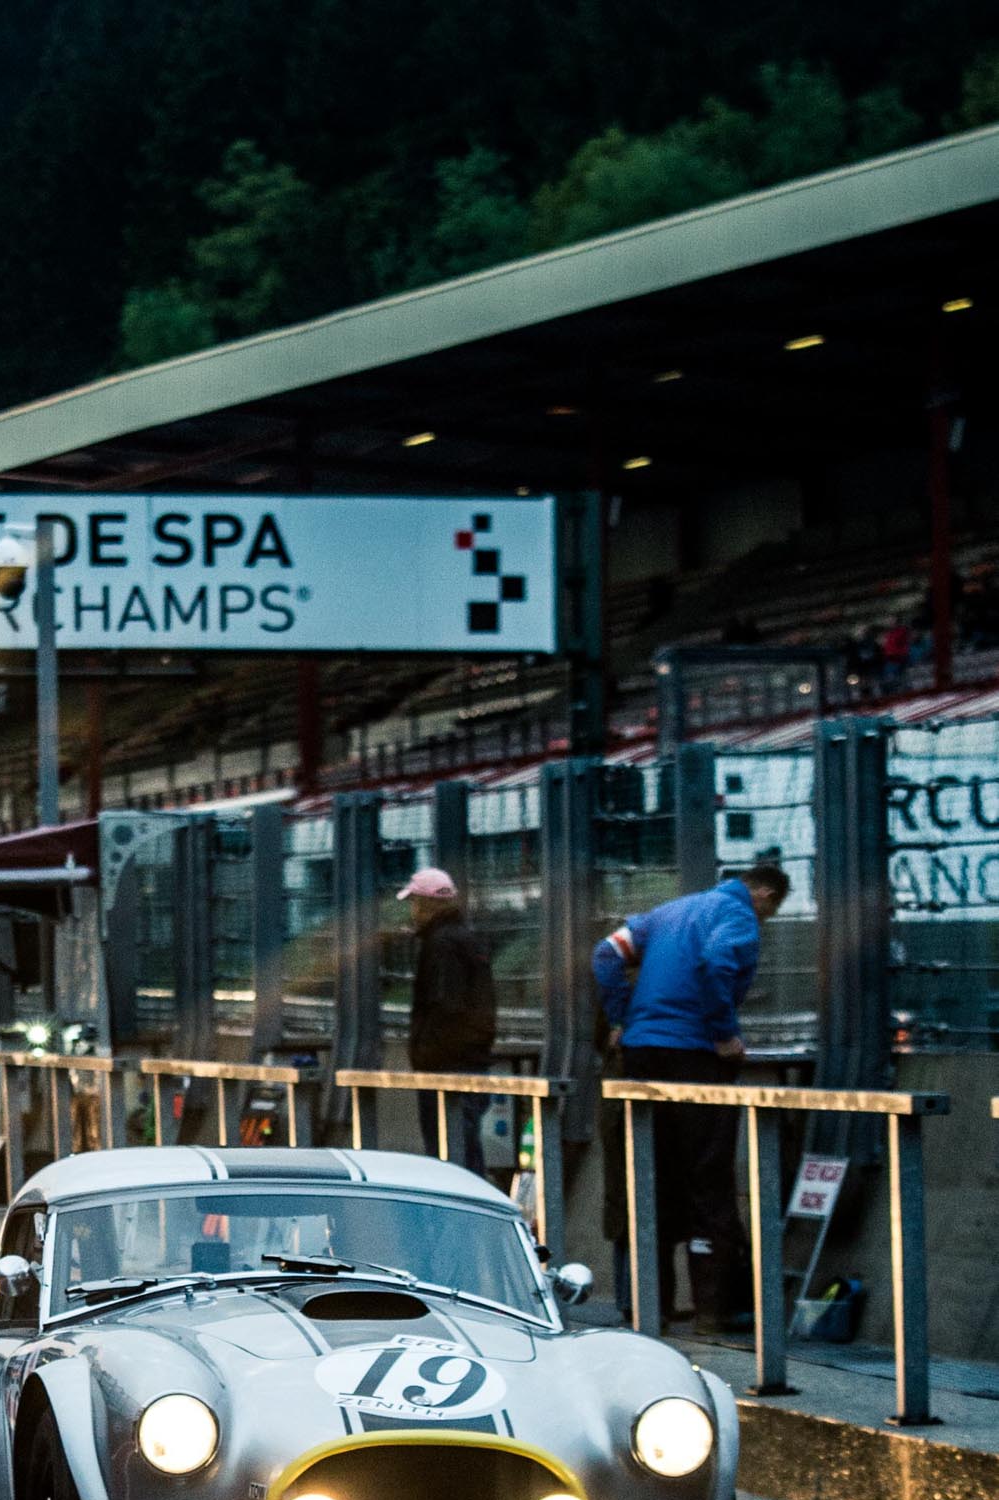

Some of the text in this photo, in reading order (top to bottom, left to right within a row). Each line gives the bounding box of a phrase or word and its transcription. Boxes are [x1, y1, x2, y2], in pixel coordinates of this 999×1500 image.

[35, 511, 129, 568] DE
[151, 511, 293, 569] SPA
[398, 1337, 454, 1351] EFG
[338, 1347, 487, 1408] 19
[336, 1397, 444, 1418] ZENITH
